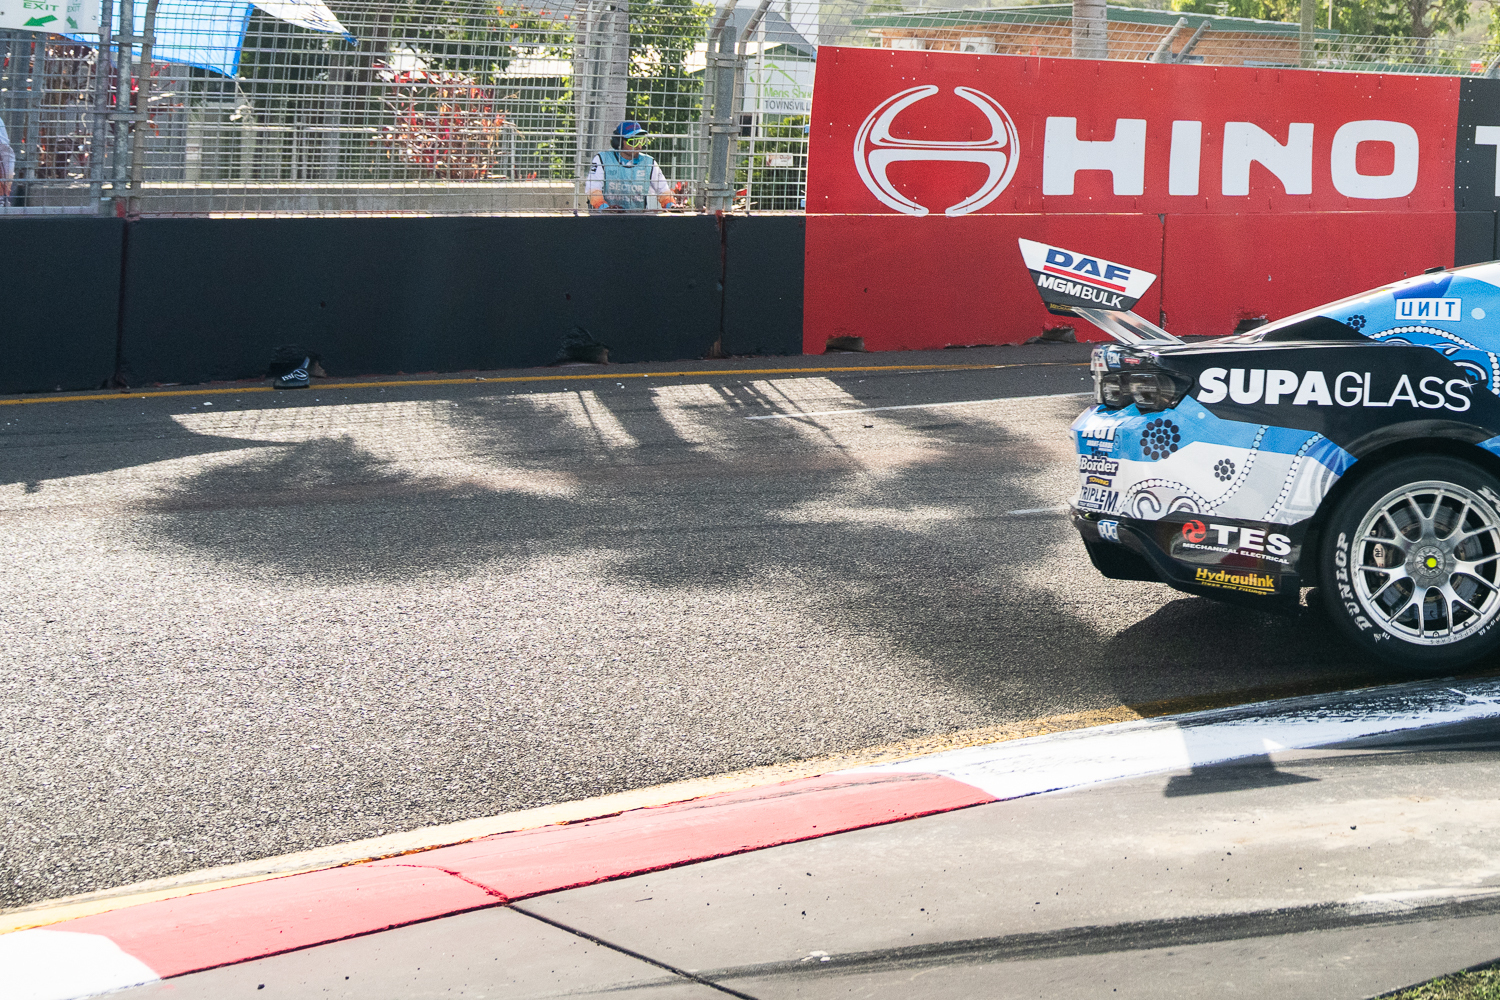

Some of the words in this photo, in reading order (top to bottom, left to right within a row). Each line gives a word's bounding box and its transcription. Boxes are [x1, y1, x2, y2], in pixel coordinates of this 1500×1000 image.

[23, 2, 59, 11] EXIT
[765, 101, 811, 110] TOWNSVILL
[1043, 117, 1421, 201] HINO
[609, 182, 644, 193] SECTOR
[1045, 248, 1131, 281] DAF
[1401, 301, 1456, 318] UNIT
[1196, 367, 1472, 412] SUPAGLASS
[1080, 456, 1118, 473] Border
[1209, 523, 1292, 556] TES
[1182, 542, 1239, 554] MECHANICAL
[1240, 551, 1290, 564] ELECTRICAL
[1195, 567, 1275, 587] Hydraulink
[1334, 532, 1373, 632] DUNLOP
